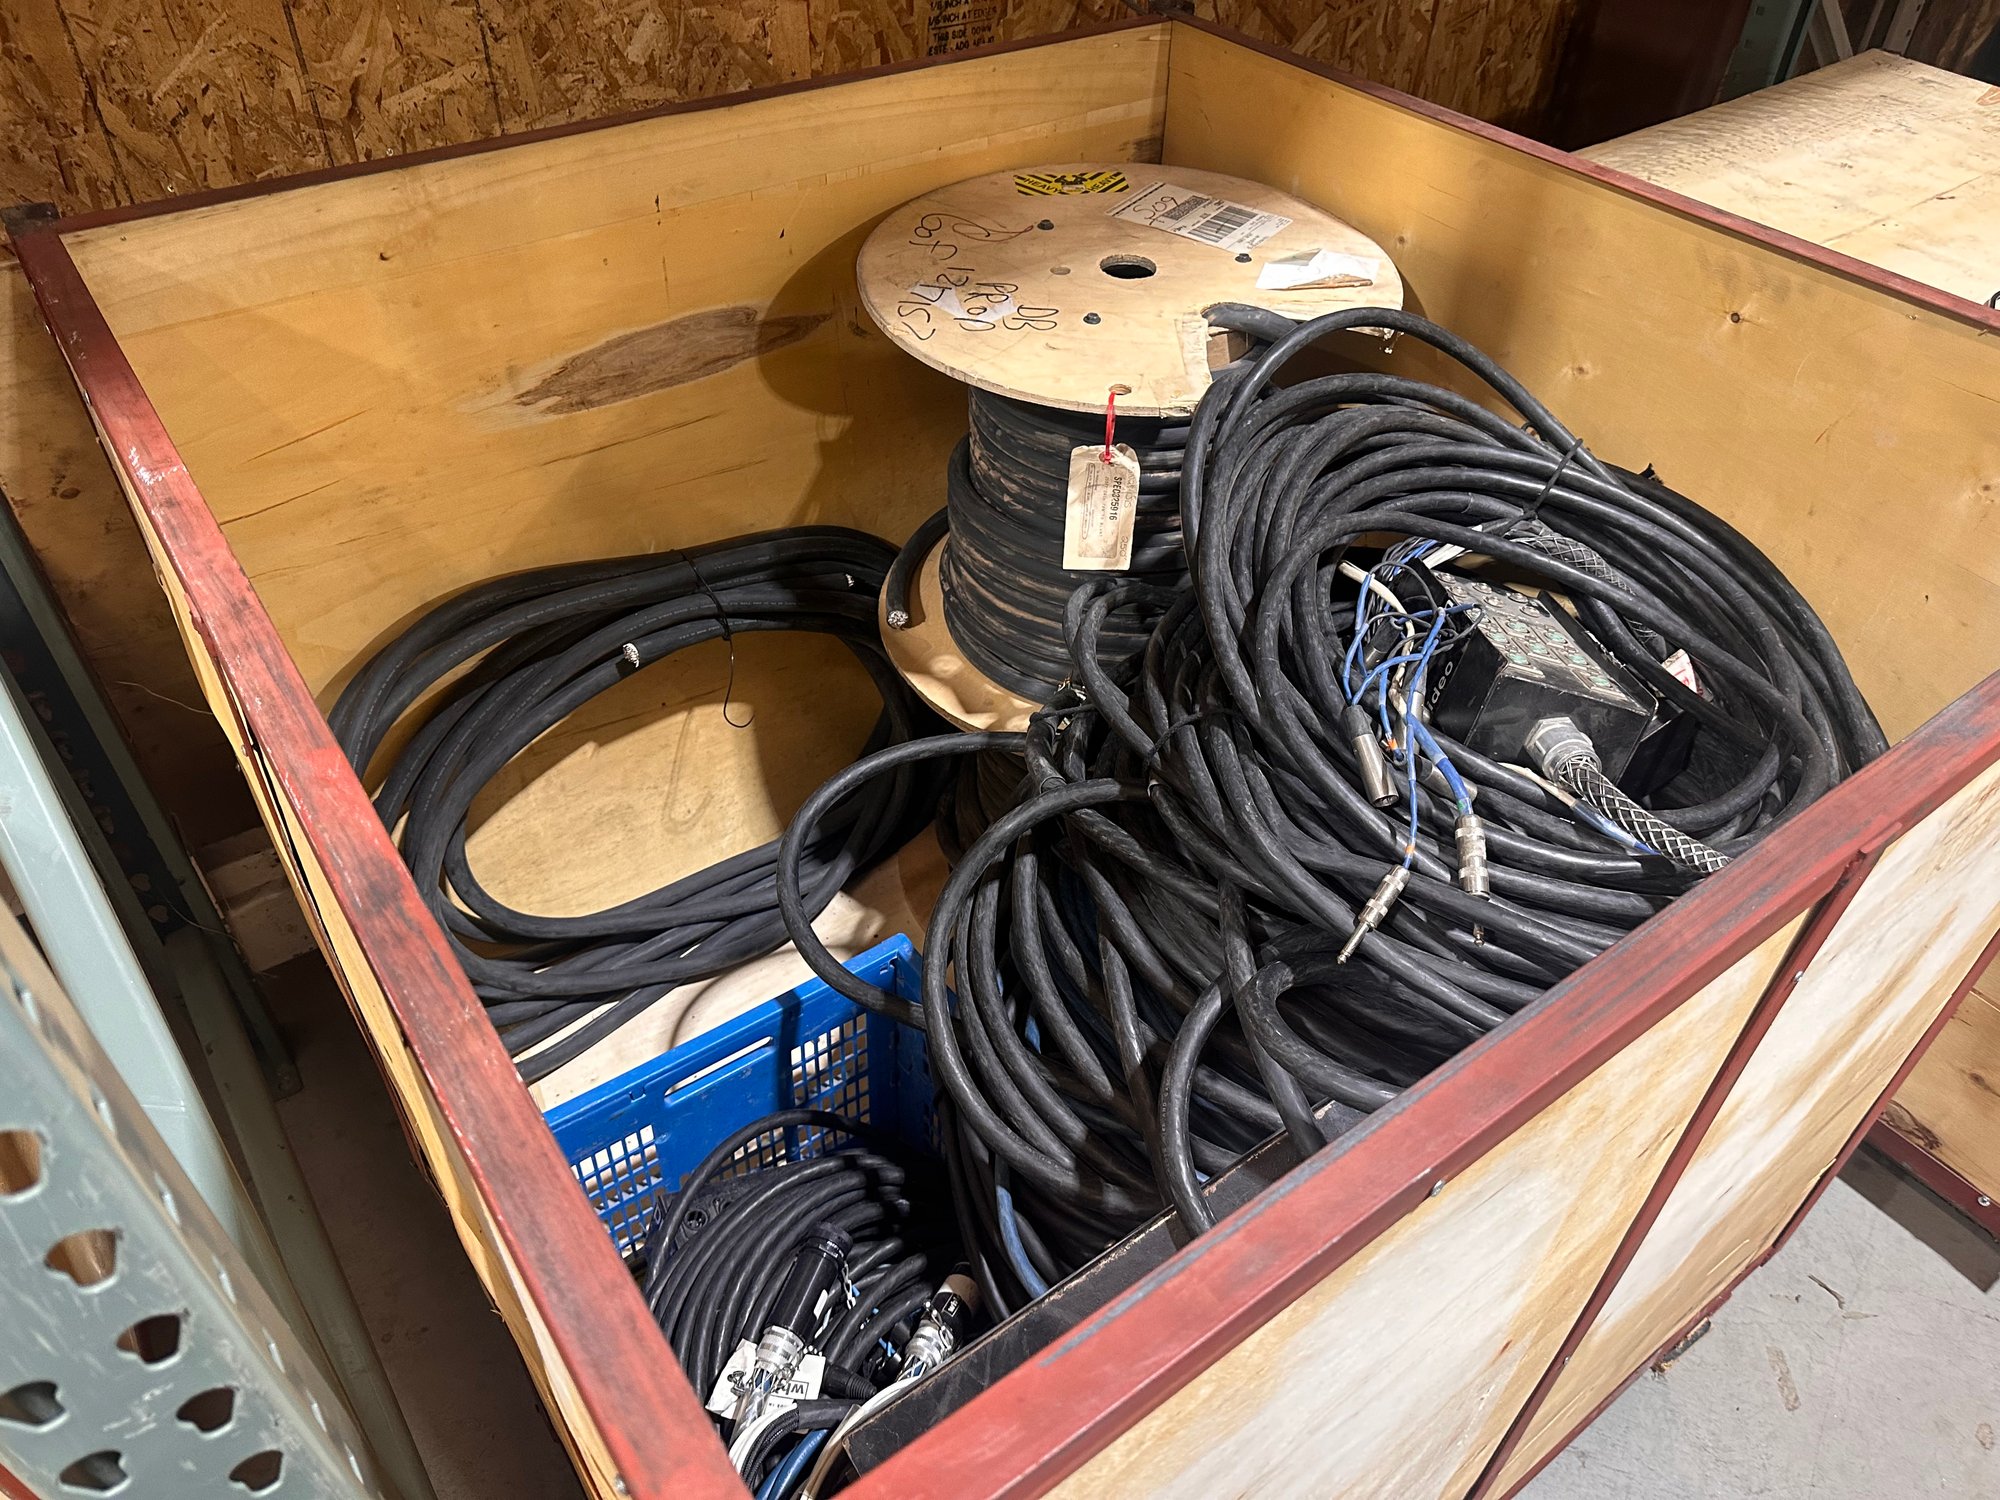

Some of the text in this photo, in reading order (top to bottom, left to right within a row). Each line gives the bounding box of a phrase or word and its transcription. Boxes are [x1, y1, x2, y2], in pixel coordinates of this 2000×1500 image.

[943, 12, 960, 23] INCH
[933, 24, 992, 42] THIS SIDE DOWN
[928, 44, 948, 56] ESTE
